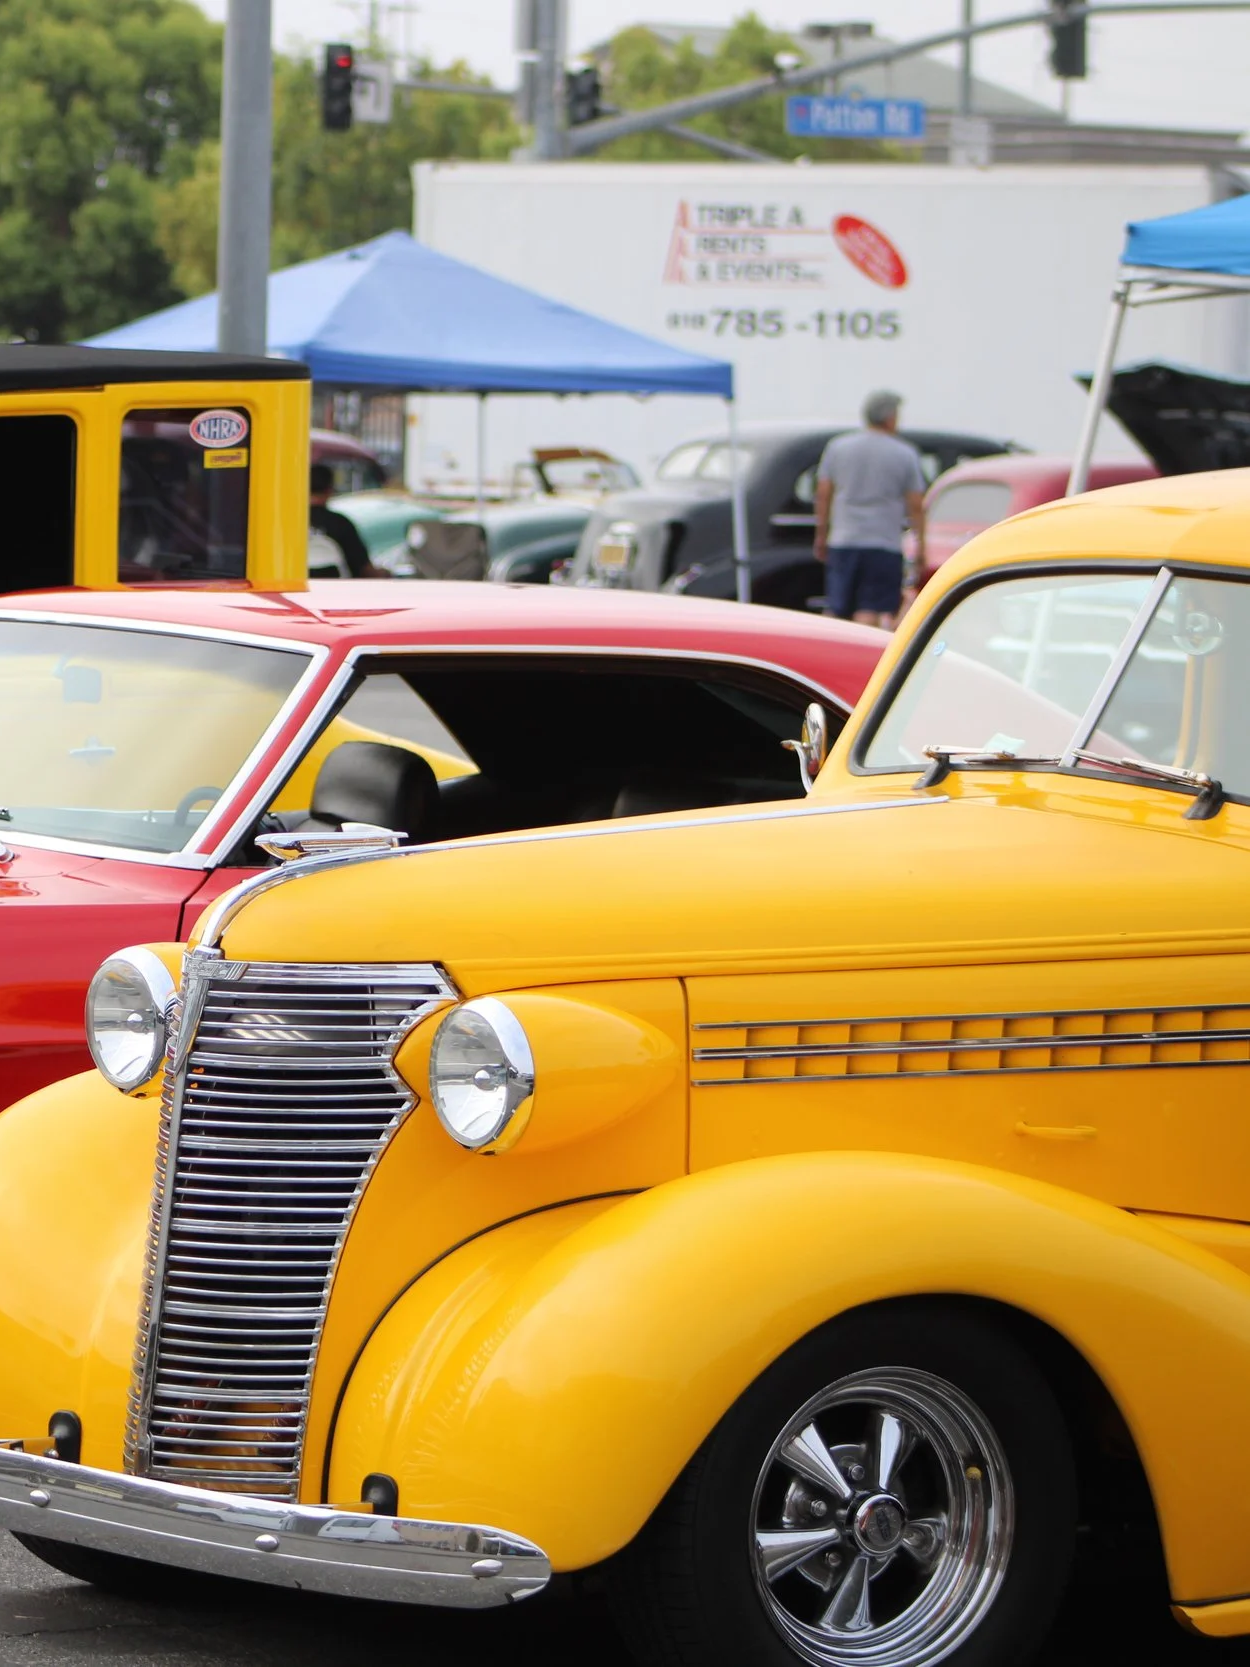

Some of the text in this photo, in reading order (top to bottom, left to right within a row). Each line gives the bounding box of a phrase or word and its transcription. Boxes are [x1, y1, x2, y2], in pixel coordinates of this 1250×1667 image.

[697, 205, 804, 228] TRIPLE A
[695, 235, 767, 254] RENTS
[716, 262, 799, 282] EVENTS
[710, 308, 784, 338] 785
[198, 418, 241, 439] NHRA
